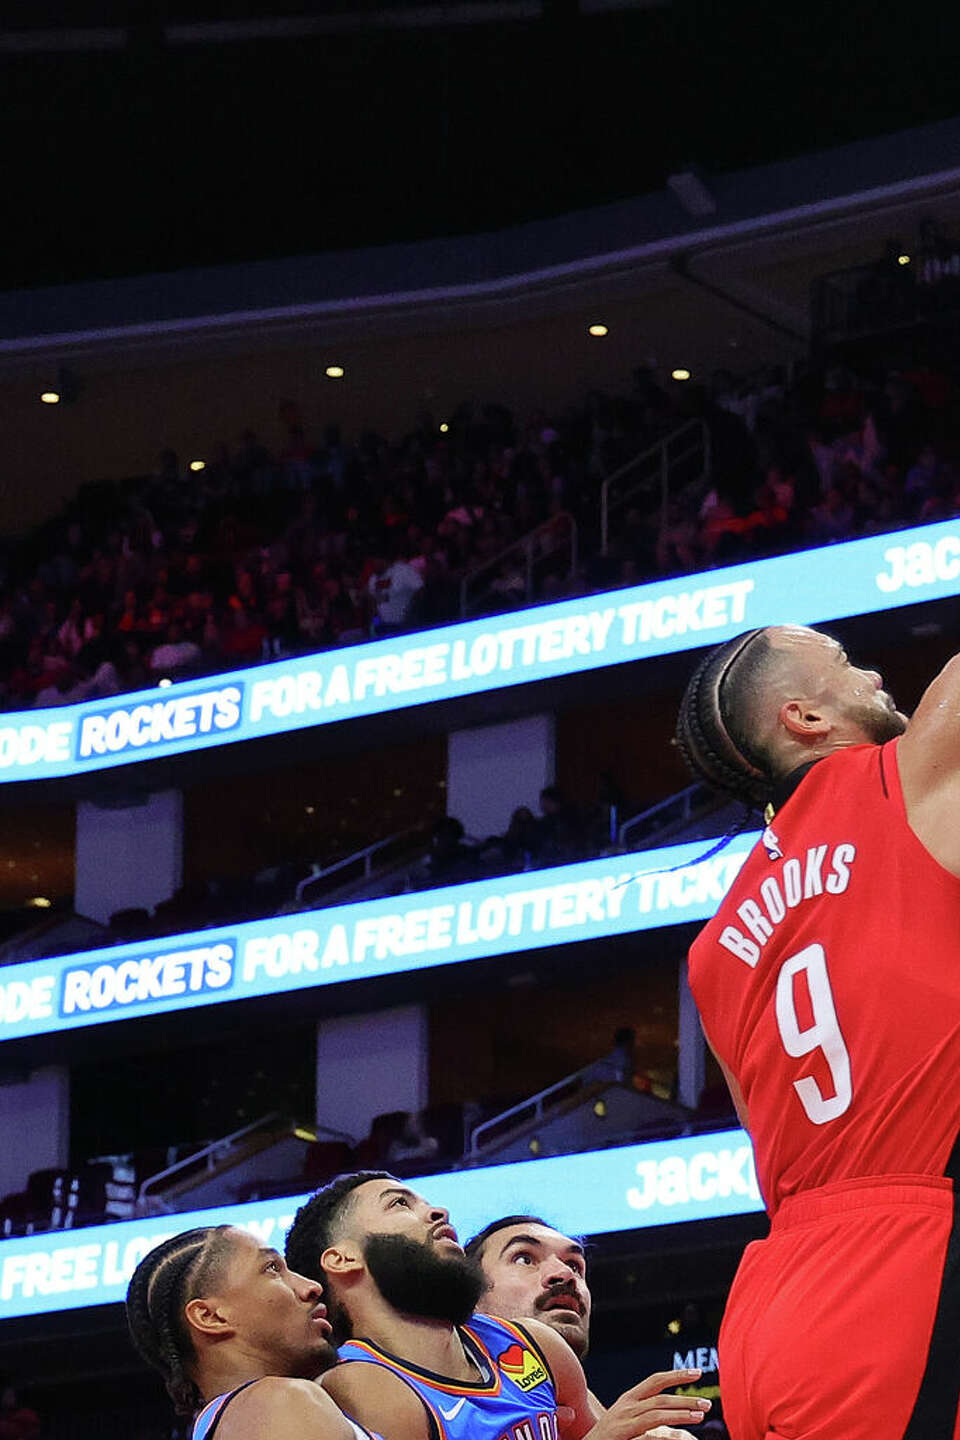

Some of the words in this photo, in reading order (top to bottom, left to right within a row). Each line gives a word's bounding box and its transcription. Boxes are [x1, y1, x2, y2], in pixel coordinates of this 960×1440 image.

[80, 687, 241, 757] ROCKETS
[250, 671, 322, 722] FOR
[324, 665, 349, 707] A
[353, 643, 449, 701] FREE
[451, 608, 616, 681] LOTTERY
[617, 579, 754, 645] TICKET
[63, 944, 233, 1013] ROCKETS
[242, 929, 319, 982] FOR
[321, 923, 350, 969] A
[351, 904, 455, 963] FREE
[456, 873, 631, 944] LOTTERY
[718, 843, 856, 969] BROOKS
[776, 942, 853, 1126] 9
[2, 1242, 99, 1300] FREE
